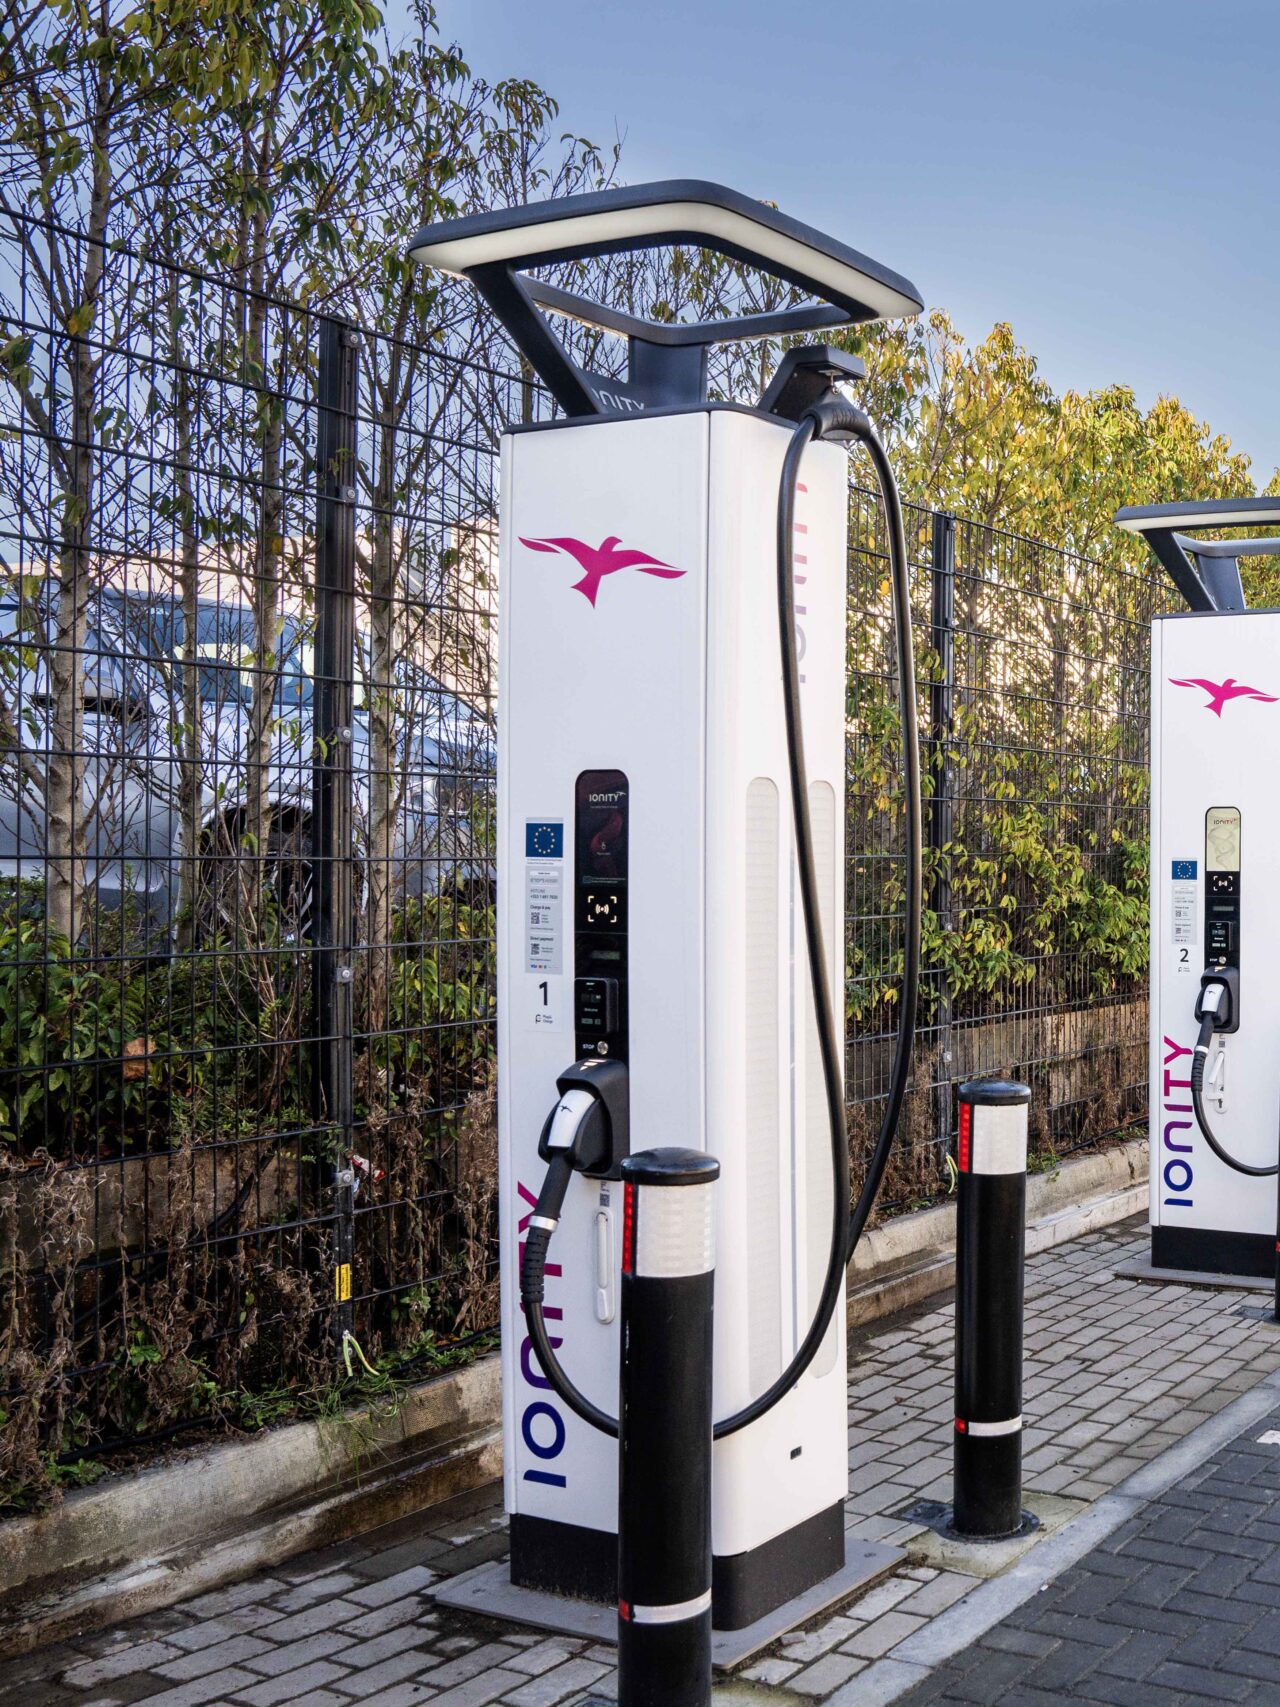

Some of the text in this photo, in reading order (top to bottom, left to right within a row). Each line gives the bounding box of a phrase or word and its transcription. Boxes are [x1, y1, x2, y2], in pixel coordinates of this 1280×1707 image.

[591, 388, 645, 411] NITY
[589, 793, 619, 802] IONITY
[1179, 948, 1189, 963] 2
[539, 981, 548, 1006] 1
[1163, 1035, 1193, 1207] IONITY
